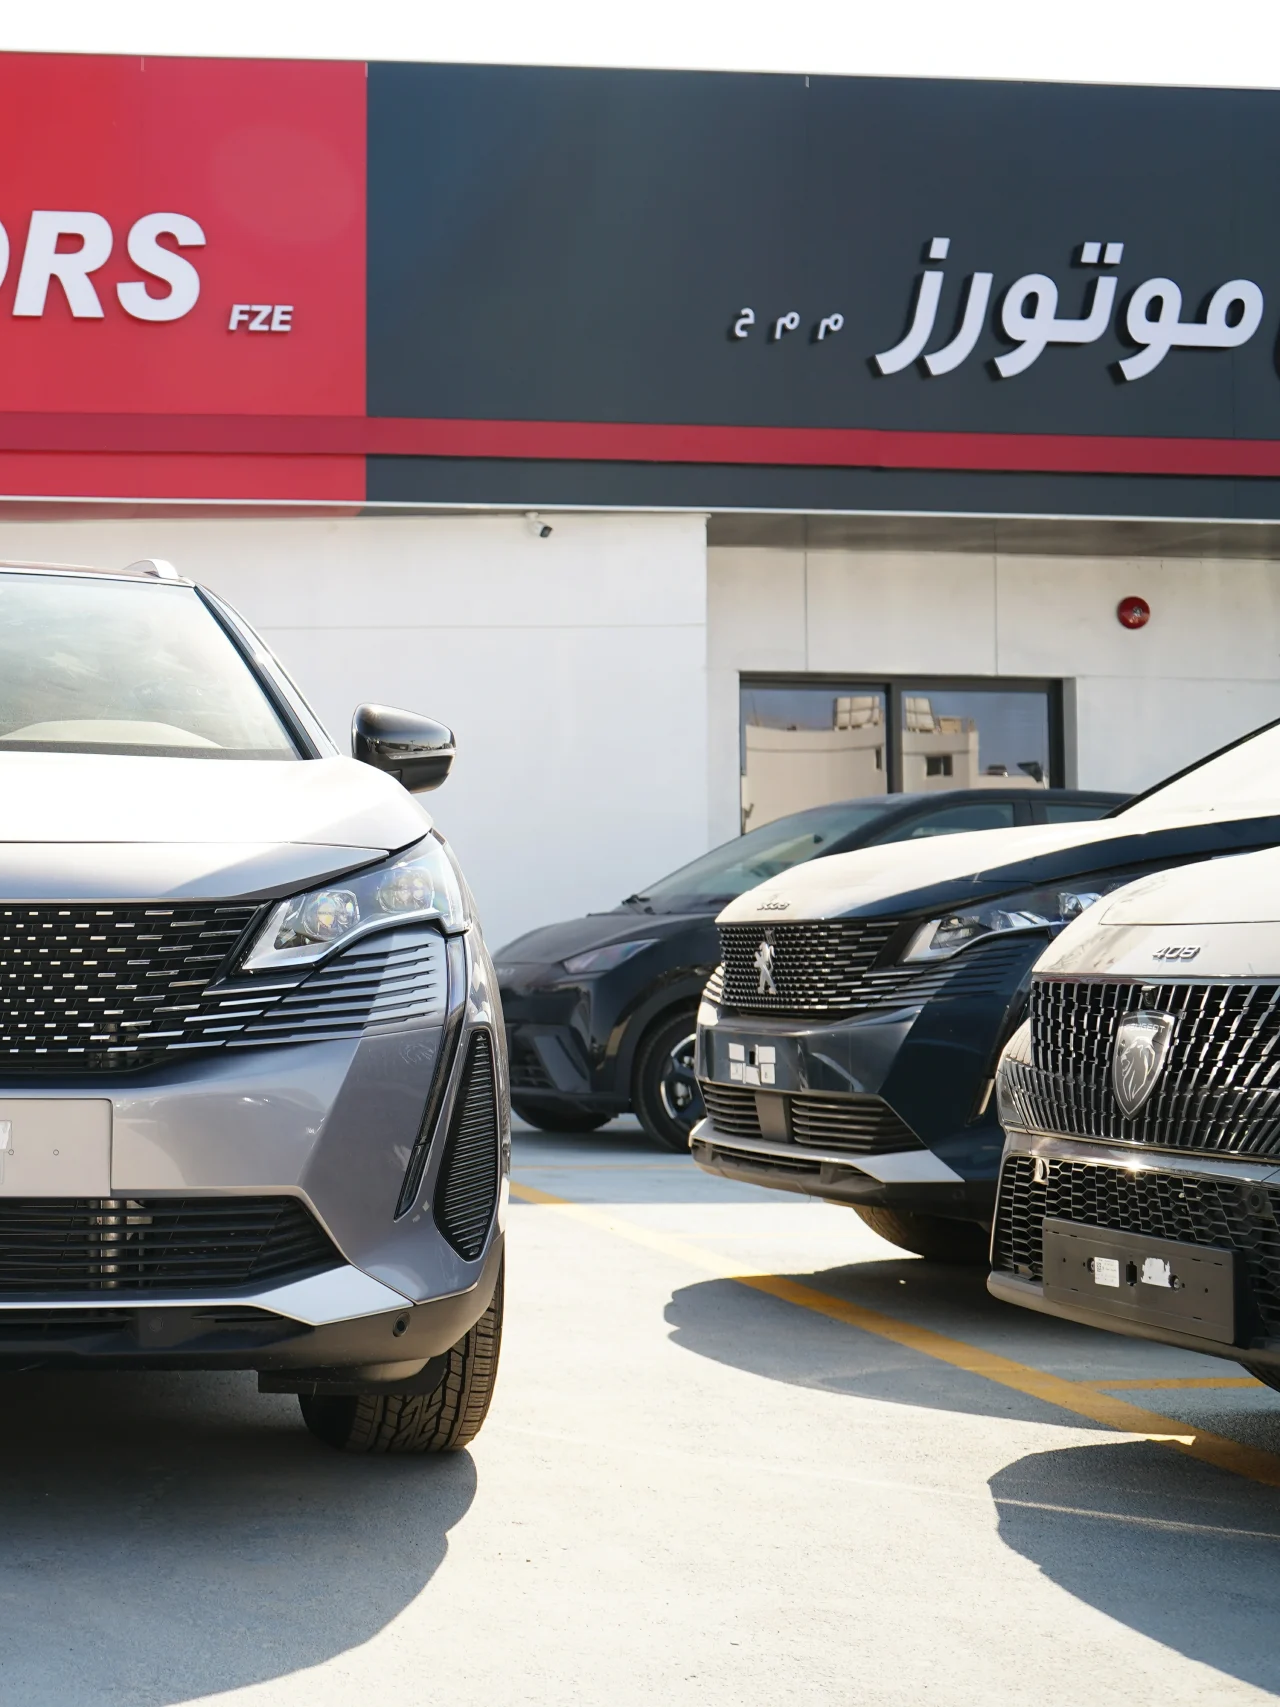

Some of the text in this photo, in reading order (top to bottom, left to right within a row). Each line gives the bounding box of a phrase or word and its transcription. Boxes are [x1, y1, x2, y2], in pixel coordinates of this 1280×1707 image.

[228, 304, 294, 332] FZE
[875, 237, 1264, 381] موتورز
[1152, 945, 1201, 961] 408
